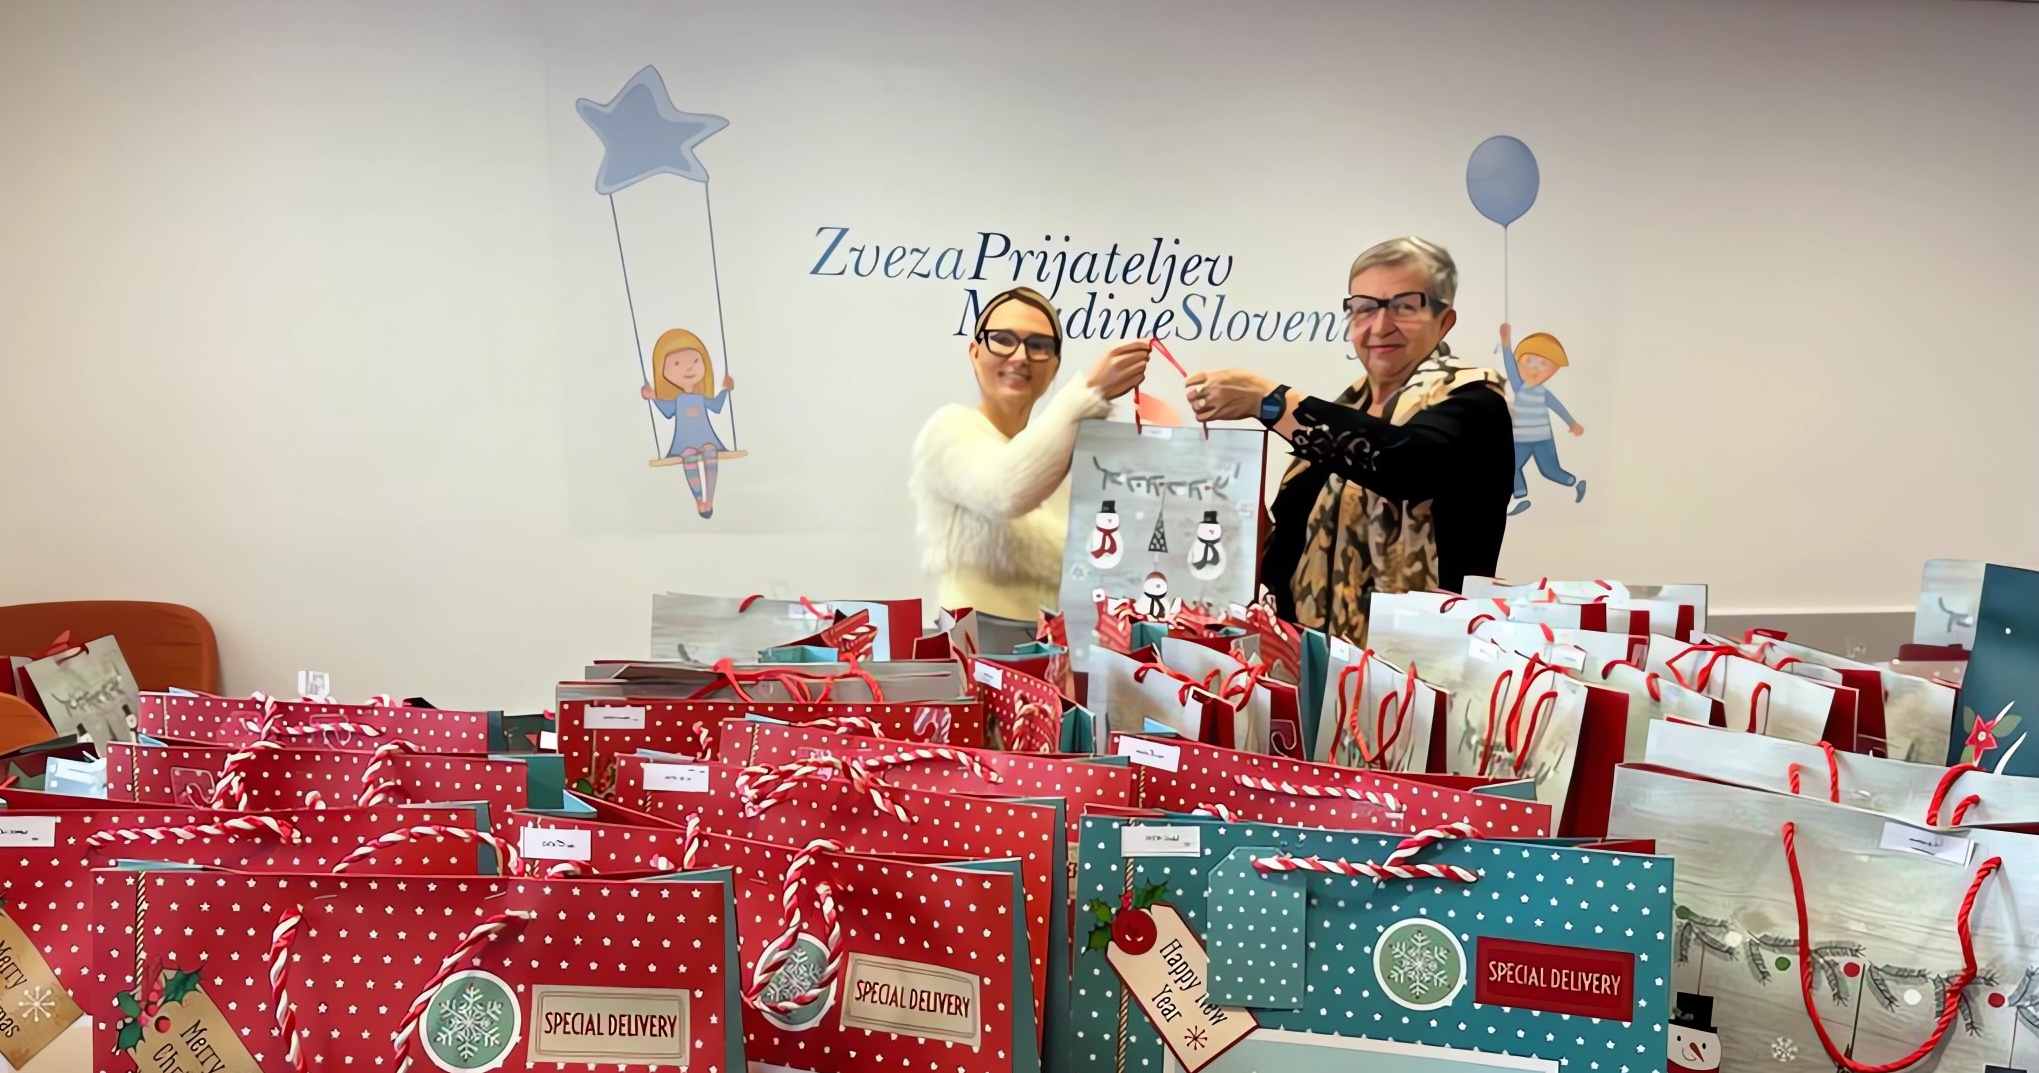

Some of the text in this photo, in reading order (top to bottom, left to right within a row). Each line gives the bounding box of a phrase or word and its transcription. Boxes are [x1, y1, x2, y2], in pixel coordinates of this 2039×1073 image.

[1159, 938, 1202, 991] Happy
[1488, 961, 1621, 996] SPECIAL DELIVERY
[854, 979, 970, 1018] SPECIAL DELIVERY
[1151, 983, 1182, 1023] Year
[544, 1011, 677, 1038] SPECIAL DELIVERY
[179, 1019, 225, 1073] Merry
